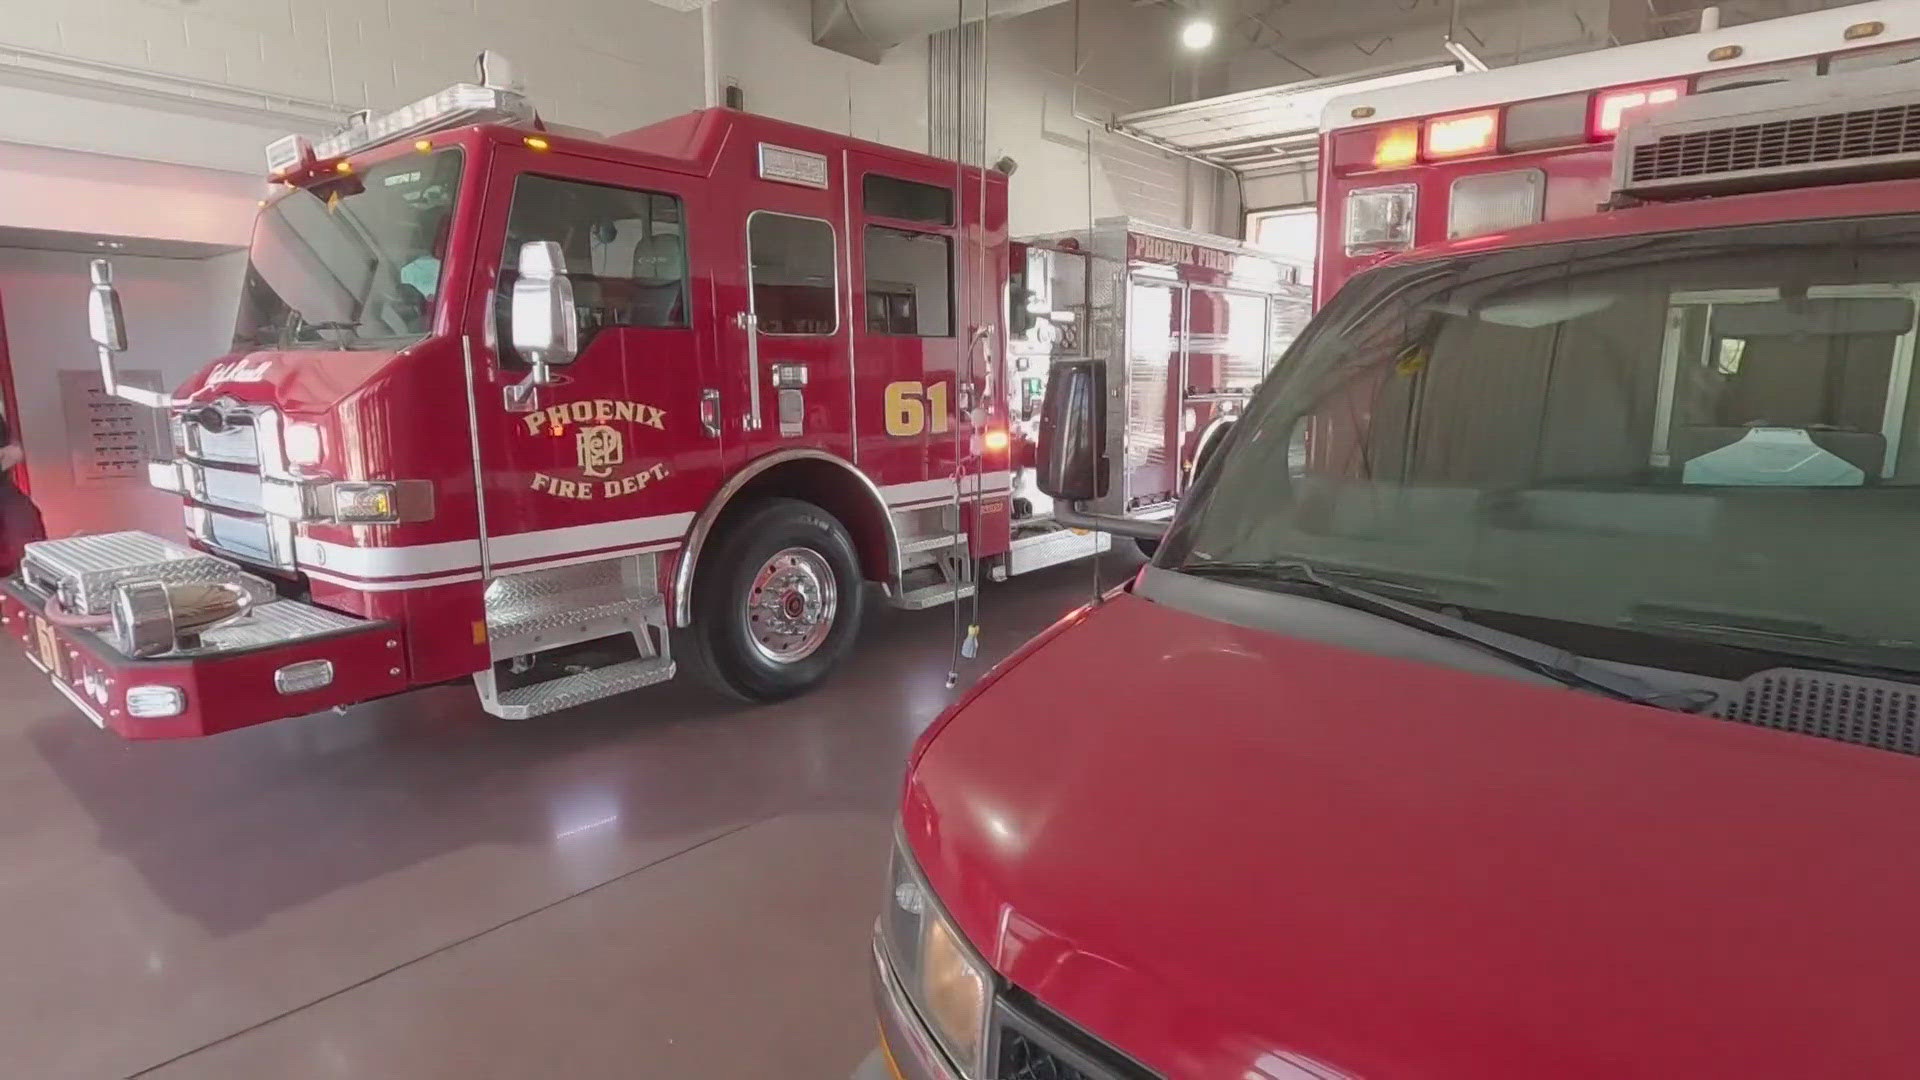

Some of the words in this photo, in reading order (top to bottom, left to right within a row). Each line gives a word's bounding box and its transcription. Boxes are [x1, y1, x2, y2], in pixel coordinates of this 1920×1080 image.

[1132, 234, 1194, 265] PHOENIX
[523, 399, 667, 436] PHOENIX
[884, 380, 948, 436] 61
[530, 472, 592, 499] FIRE
[604, 462, 669, 498] DEPT.
[35, 615, 62, 678] 61
